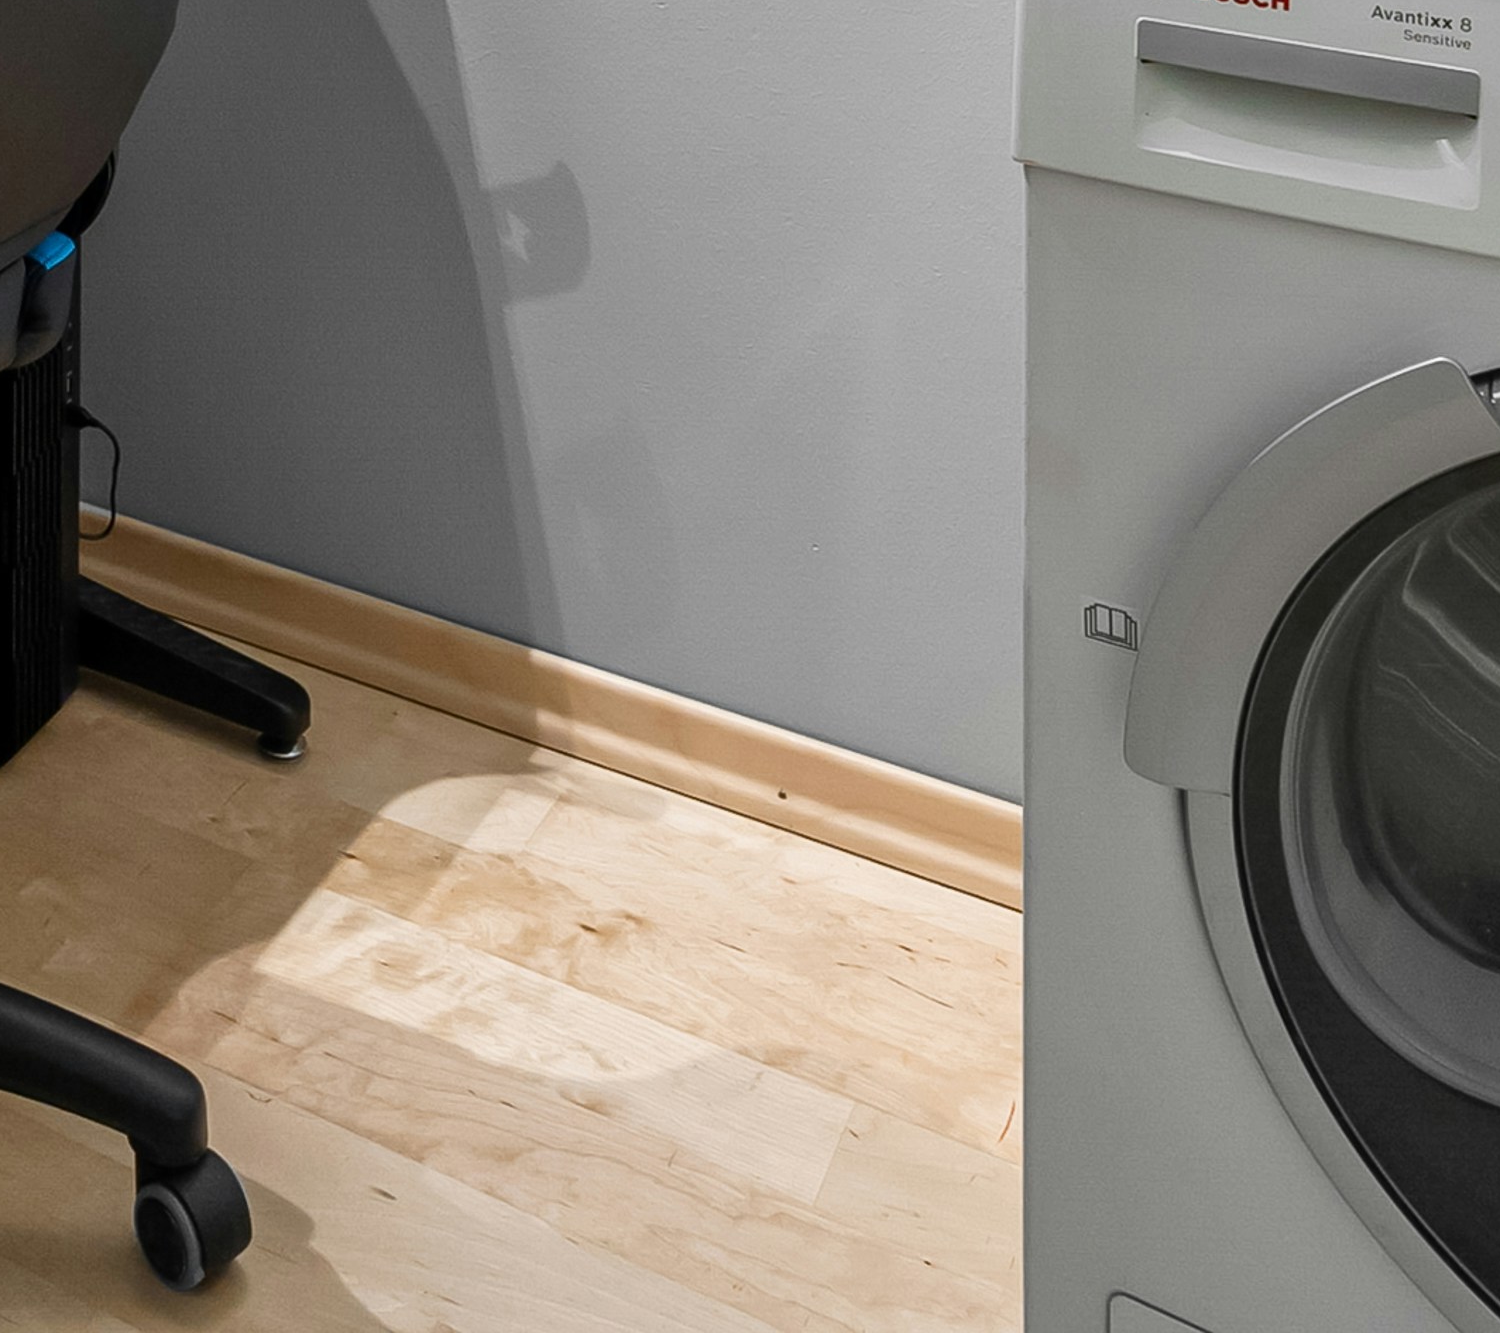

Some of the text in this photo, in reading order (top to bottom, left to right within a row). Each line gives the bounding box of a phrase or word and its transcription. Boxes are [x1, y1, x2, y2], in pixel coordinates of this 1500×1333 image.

[1370, 4, 1473, 33] Avantixx 8
[1403, 28, 1472, 51] Sensitive
